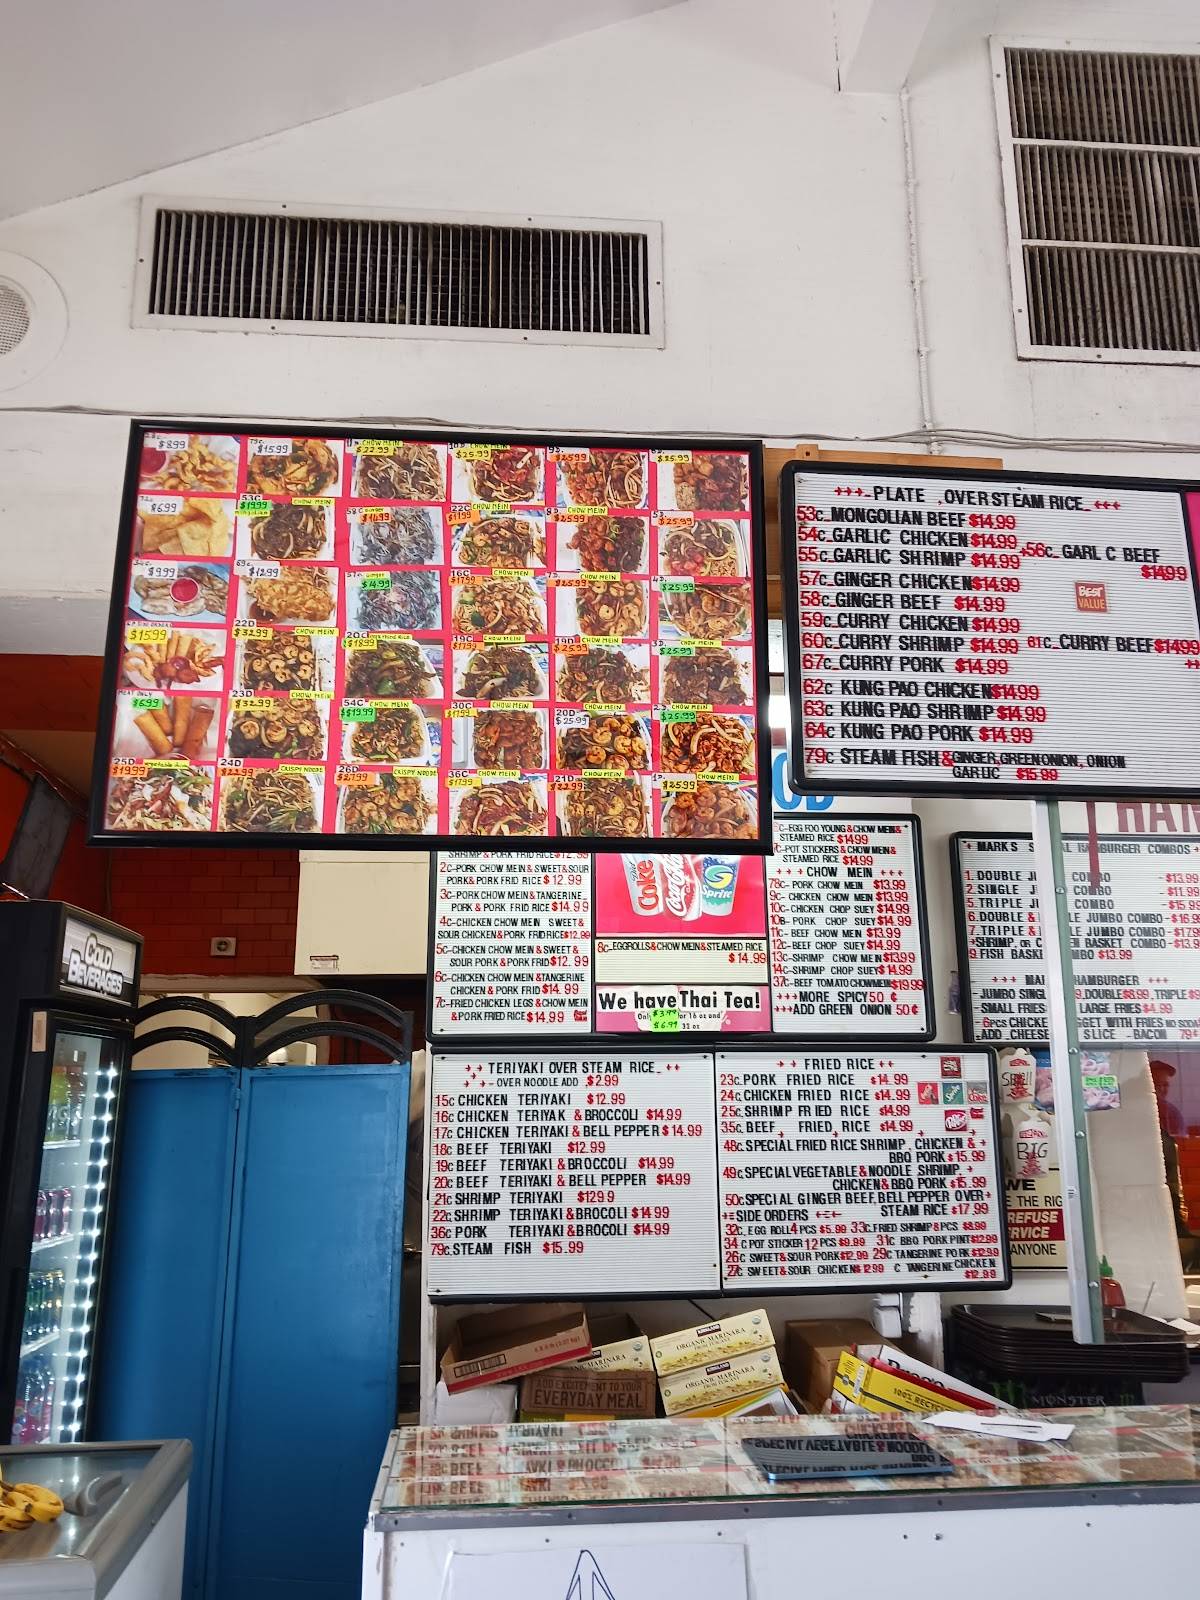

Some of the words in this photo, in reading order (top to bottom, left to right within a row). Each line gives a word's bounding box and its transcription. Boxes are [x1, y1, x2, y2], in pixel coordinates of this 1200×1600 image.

[874, 486, 925, 502] PLATE
[992, 493, 1044, 509] STEAM
[1050, 495, 1083, 510] RICE
[831, 507, 922, 525] MONGOLIAN
[927, 512, 966, 527] BEEF
[969, 514, 1016, 530] $14.99
[832, 528, 891, 544] GARLIC
[900, 530, 968, 547] CHICKEN
[971, 533, 1017, 550] $14.99
[833, 548, 891, 564] GARLIC
[900, 550, 966, 566] SHRIMP
[971, 553, 1020, 569] $14.99
[834, 572, 892, 588] GINGER
[900, 574, 972, 590] CHICKEN
[972, 577, 1020, 592] $14.99
[836, 592, 894, 608] GINGER
[901, 594, 941, 610] BEEF
[954, 595, 1007, 613] $14.99
[1078, 598, 1105, 609] VALUE
[837, 613, 890, 628] CURRY
[900, 615, 968, 631] CHICKEN
[972, 617, 1020, 633] $14.99
[839, 634, 891, 650] CURRY
[900, 636, 965, 652] SHRIMP
[970, 637, 1019, 655] $14.99
[839, 654, 893, 671] CURRY
[900, 657, 945, 673] PORK
[955, 658, 1009, 675] $14.99
[232, 690, 253, 698] 23D
[841, 679, 885, 696] KUNG
[889, 681, 918, 696] PAO
[925, 682, 992, 699] CHICKEN
[841, 701, 885, 717] KUNG
[889, 703, 921, 719] PAO
[927, 704, 994, 720] SHRIMP
[997, 705, 1046, 723] $14.99
[555, 717, 587, 725] $25.99
[220, 759, 241, 767] 24D
[448, 770, 469, 778] 36C
[977, 842, 1018, 851] MARKS
[1148, 845, 1190, 854] COMBOS
[807, 867, 838, 878] CHOW
[848, 867, 873, 878] MEIN
[977, 871, 1023, 881] DOUBLE
[792, 881, 814, 889] PORK
[817, 881, 840, 889] CHOW
[844, 881, 863, 890] MEIN
[873, 880, 906, 890] $13.99
[978, 884, 1019, 895] SINGLE
[451, 904, 472, 912] PORK
[483, 903, 506, 911] PORK
[510, 903, 529, 911] FRID
[532, 903, 550, 911] RICE
[551, 901, 589, 912] $14.99
[791, 905, 824, 914] CHICKEN
[829, 905, 850, 914] CHOP
[854, 905, 874, 914] SUEY
[876, 904, 910, 914] $14.99
[979, 898, 1022, 909] TRIPLE
[1075, 899, 1114, 909] COMBO
[1086, 913, 1123, 924] JUMBO
[1127, 913, 1163, 924] COMBO
[791, 929, 809, 938] BEEF
[814, 929, 838, 938] CHOW
[842, 929, 861, 938] MEIN
[866, 928, 901, 939] $13.99
[980, 950, 1004, 959] FISH
[1098, 950, 1133, 960] $13.99
[450, 986, 486, 995] CHICKEN
[496, 986, 519, 995] PORK
[521, 986, 541, 994] FRID
[599, 992, 627, 1009] We
[634, 991, 677, 1009] have
[680, 990, 717, 1008] Thai
[725, 991, 760, 1008] Tea!
[799, 992, 829, 1002] MORE
[838, 992, 868, 1003] SPICY
[819, 1004, 852, 1015] GREEN
[860, 1003, 891, 1015] ONION
[488, 1062, 544, 1074] TERIYAKI
[549, 1062, 577, 1074] OVER
[582, 1062, 622, 1073] STEAM
[629, 1062, 655, 1073] RICE
[804, 1059, 840, 1070] FRIED
[846, 1059, 875, 1070] RICE
[743, 1074, 777, 1085] PORK
[787, 1074, 821, 1085] FRIED
[827, 1074, 855, 1085] RICE
[870, 1074, 909, 1085] $14.99
[458, 1094, 508, 1106] CHICKEN
[518, 1093, 571, 1106] TERIYAKI
[587, 1093, 626, 1105] $12.99
[744, 1090, 792, 1101] CHICKEN
[798, 1090, 831, 1101] FRIED
[840, 1089, 869, 1101] RICE
[875, 1090, 910, 1100] $14.99
[457, 1144, 489, 1155] BEEF
[500, 1143, 552, 1155] TERIYAKI
[567, 1142, 606, 1153] $12.99
[915, 1137, 963, 1149] CHICKEN
[1017, 1142, 1048, 1160] BIG
[889, 1152, 912, 1163] BBQ
[916, 1152, 945, 1163] PORK
[456, 1176, 488, 1188] BEEF
[569, 1175, 597, 1186] BELL
[601, 1174, 647, 1186] PEPPER
[455, 1193, 501, 1205] SHRIMP
[510, 1192, 563, 1204] TERIYAKI
[1019, 1196, 1039, 1206] THE
[736, 1210, 763, 1221] SIDE
[764, 1210, 808, 1221] ORDERS
[881, 1205, 919, 1217] STEAM
[923, 1204, 948, 1216] RICE
[1007, 1211, 1058, 1223] REFUSE
[453, 1242, 493, 1255] STEAM
[504, 1242, 531, 1254] FISH
[542, 1241, 584, 1253] $15.99
[1010, 1245, 1057, 1255] ANYONE
[707, 1327, 746, 1342] MARINARA
[718, 1365, 756, 1381] MARINARA
[621, 1382, 642, 1391] YOUR
[535, 1391, 605, 1406] EVERYDAY
[607, 1392, 642, 1408] MEAL
